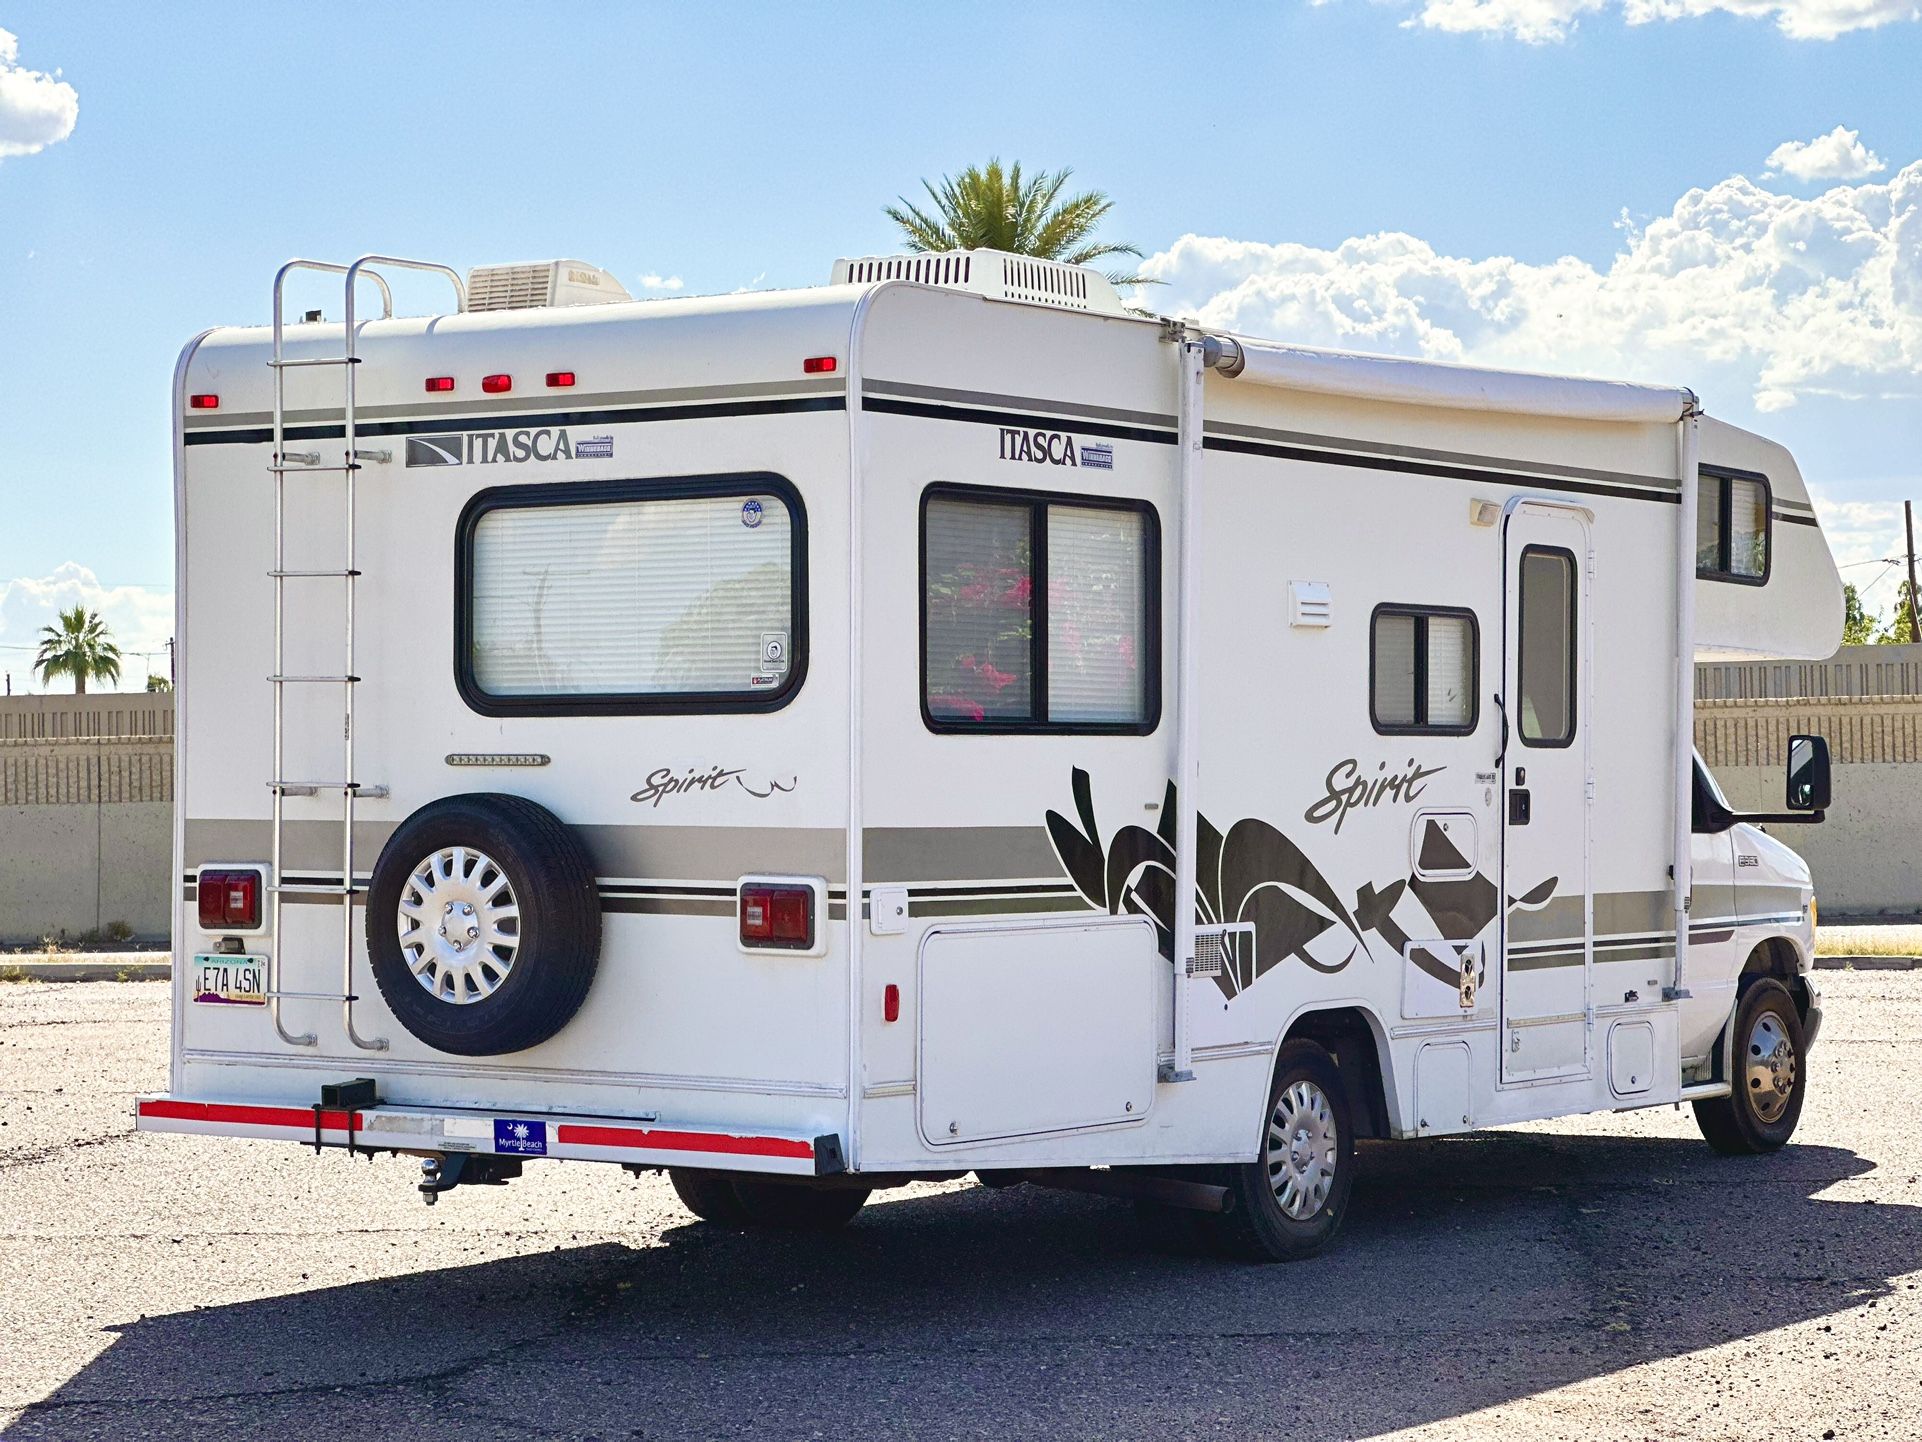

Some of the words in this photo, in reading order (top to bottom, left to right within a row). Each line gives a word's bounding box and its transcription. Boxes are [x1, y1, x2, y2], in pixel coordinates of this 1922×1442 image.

[466, 429, 573, 464] ITASCA
[999, 428, 1077, 467] ITASCA
[630, 765, 747, 808] Spirit
[1304, 758, 1447, 835] Spirit
[204, 967, 229, 992] E7A
[235, 968, 260, 993] 4SN
[499, 1138, 520, 1148] Myrtle
[522, 1139, 543, 1149] Beach
